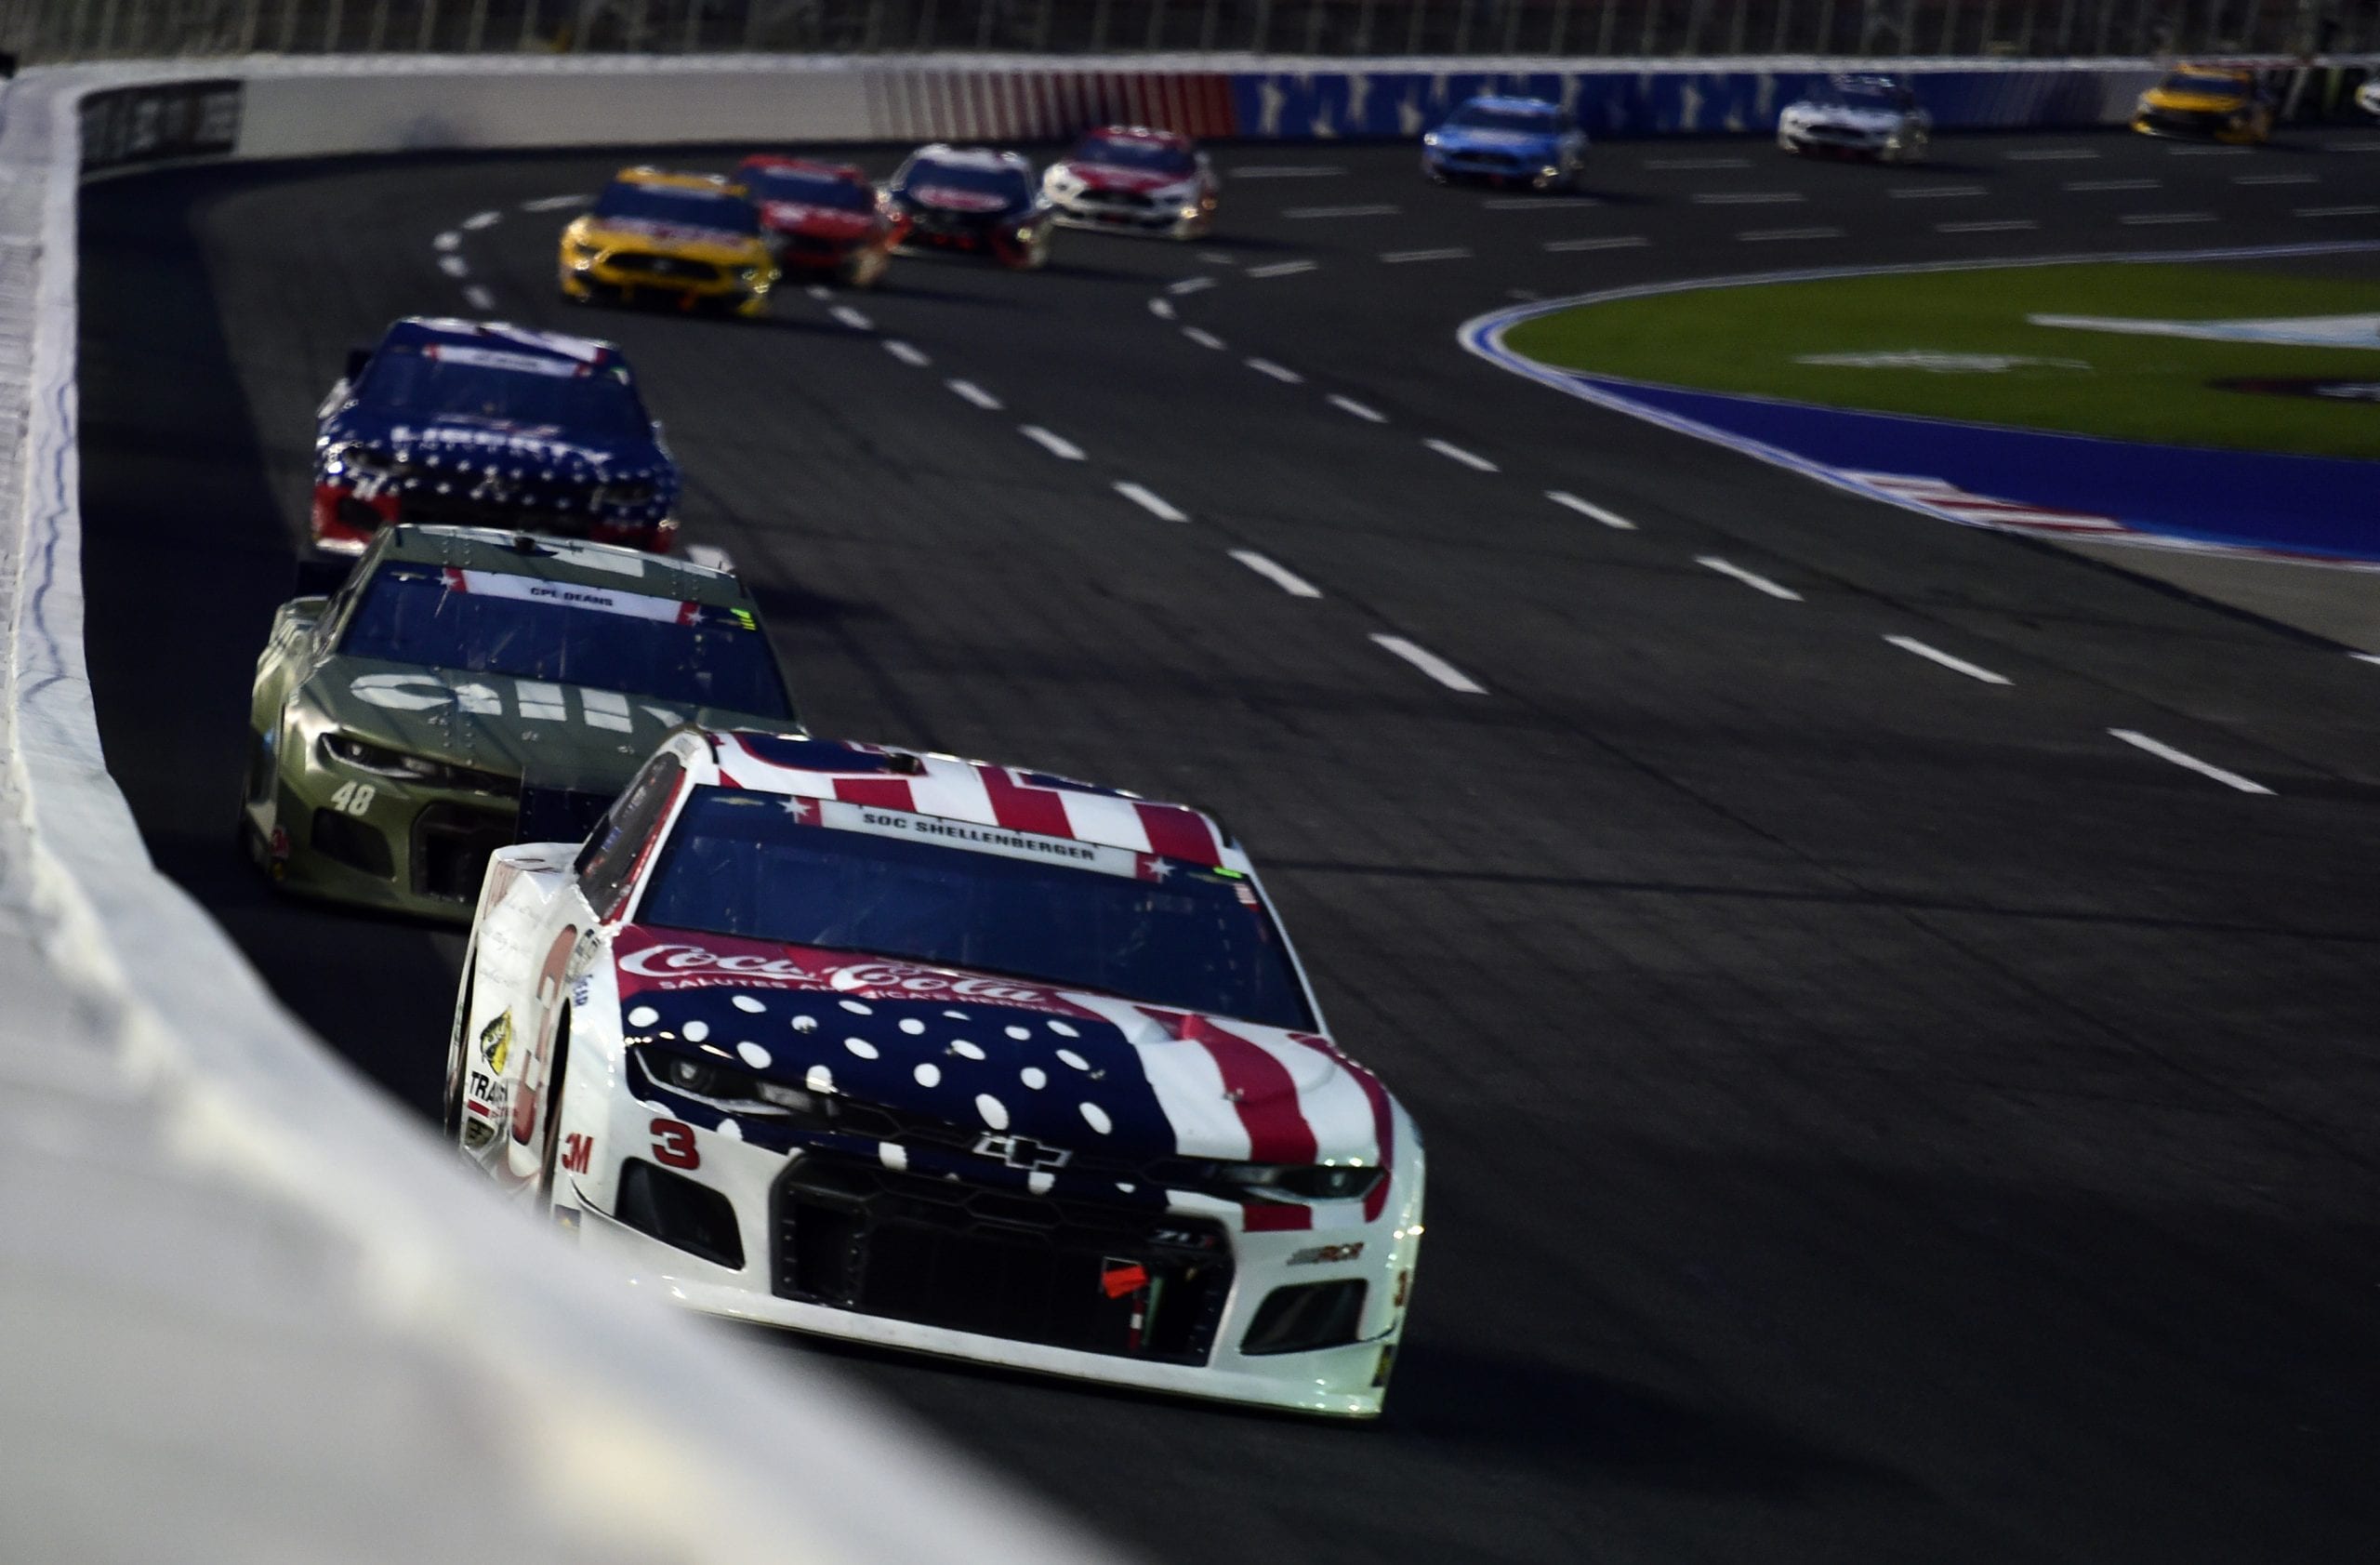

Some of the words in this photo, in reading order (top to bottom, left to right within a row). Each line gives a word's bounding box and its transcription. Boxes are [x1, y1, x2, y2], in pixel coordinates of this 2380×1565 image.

[530, 587, 558, 598] CPL
[563, 591, 614, 605] DEANS
[331, 780, 376, 816] 48
[863, 813, 906, 829] SOC
[915, 821, 1095, 861] SHELLENBERGER
[658, 977, 789, 990] SALUTES
[562, 1131, 594, 1175] 3M
[649, 1118, 701, 1171] 3
